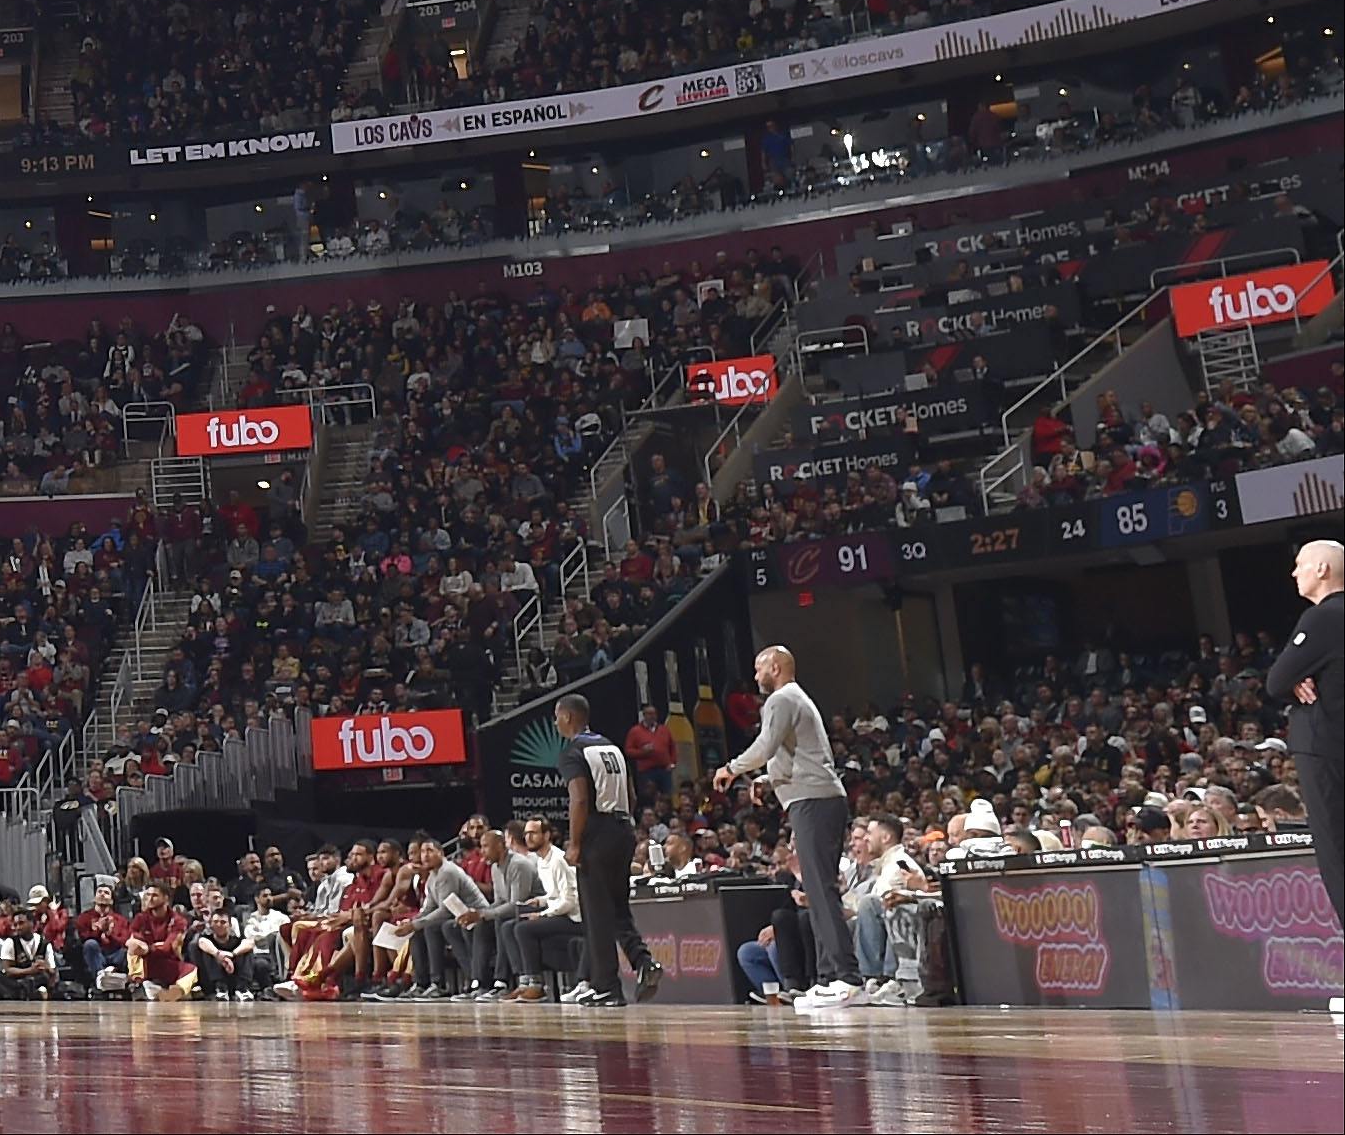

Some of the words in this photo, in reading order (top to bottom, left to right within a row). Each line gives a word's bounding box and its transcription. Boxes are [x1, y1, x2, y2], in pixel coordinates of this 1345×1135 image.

[418, 5, 441, 18] 203
[454, 0, 477, 13] 204
[682, 75, 728, 94] MEGA
[354, 124, 385, 146] LOS
[389, 115, 432, 142] CAVS
[463, 114, 486, 132] EN
[491, 104, 568, 127] ESPAÑOL
[21, 156, 59, 173] 9:13
[65, 154, 95, 170] PM
[129, 146, 181, 165] LET
[185, 142, 226, 162] EM
[228, 130, 321, 157] KNOW.
[1016, 221, 1081, 245] Homes
[503, 261, 544, 279] M103
[1208, 280, 1297, 323] fubo
[206, 415, 279, 448] fubo
[770, 457, 843, 481] ROCKET
[845, 452, 899, 471] Homes
[756, 568, 767, 586] 5
[838, 545, 868, 572] 91
[970, 529, 1020, 555] 2:27
[1061, 519, 1086, 540] 24
[1116, 502, 1148, 535] 85
[1216, 499, 1228, 519] 3
[338, 716, 434, 764] fubo
[1039, 949, 1106, 984] ENERGY
